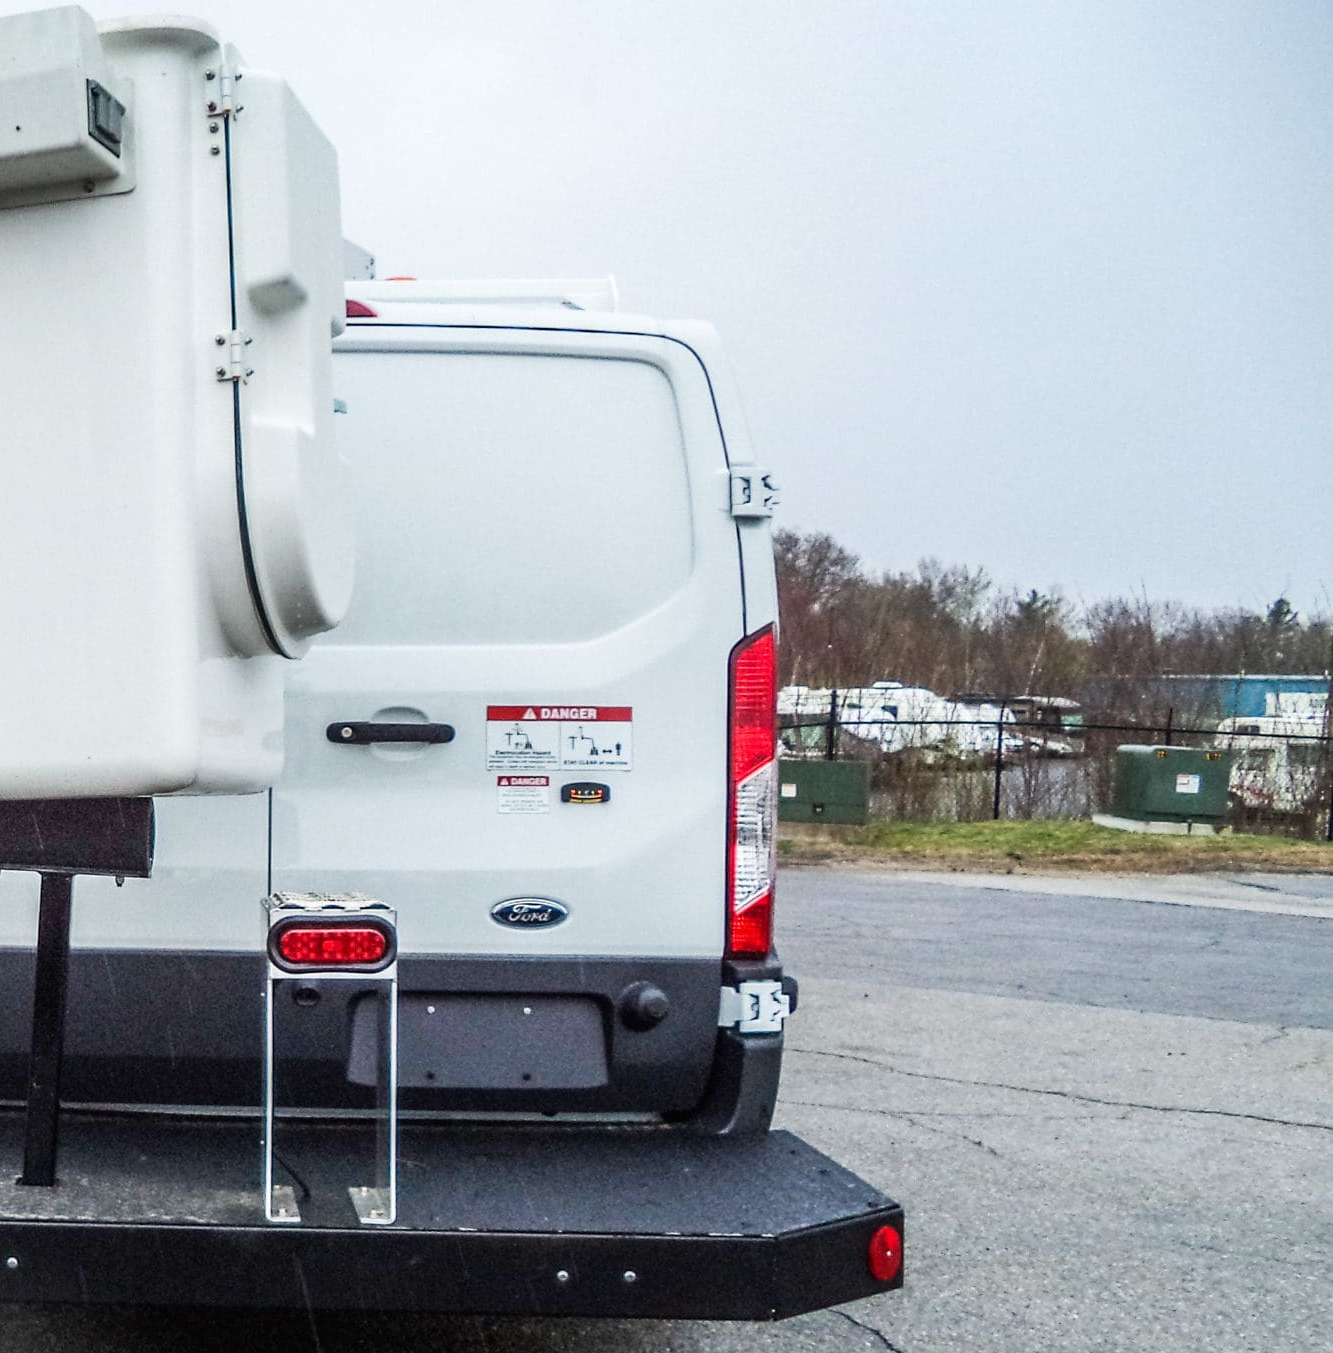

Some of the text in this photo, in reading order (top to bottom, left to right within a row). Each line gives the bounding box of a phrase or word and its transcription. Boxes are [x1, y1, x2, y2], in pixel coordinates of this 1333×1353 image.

[540, 707, 597, 720] DANGER
[510, 777, 547, 786] DANGER
[508, 904, 553, 922] Ford
